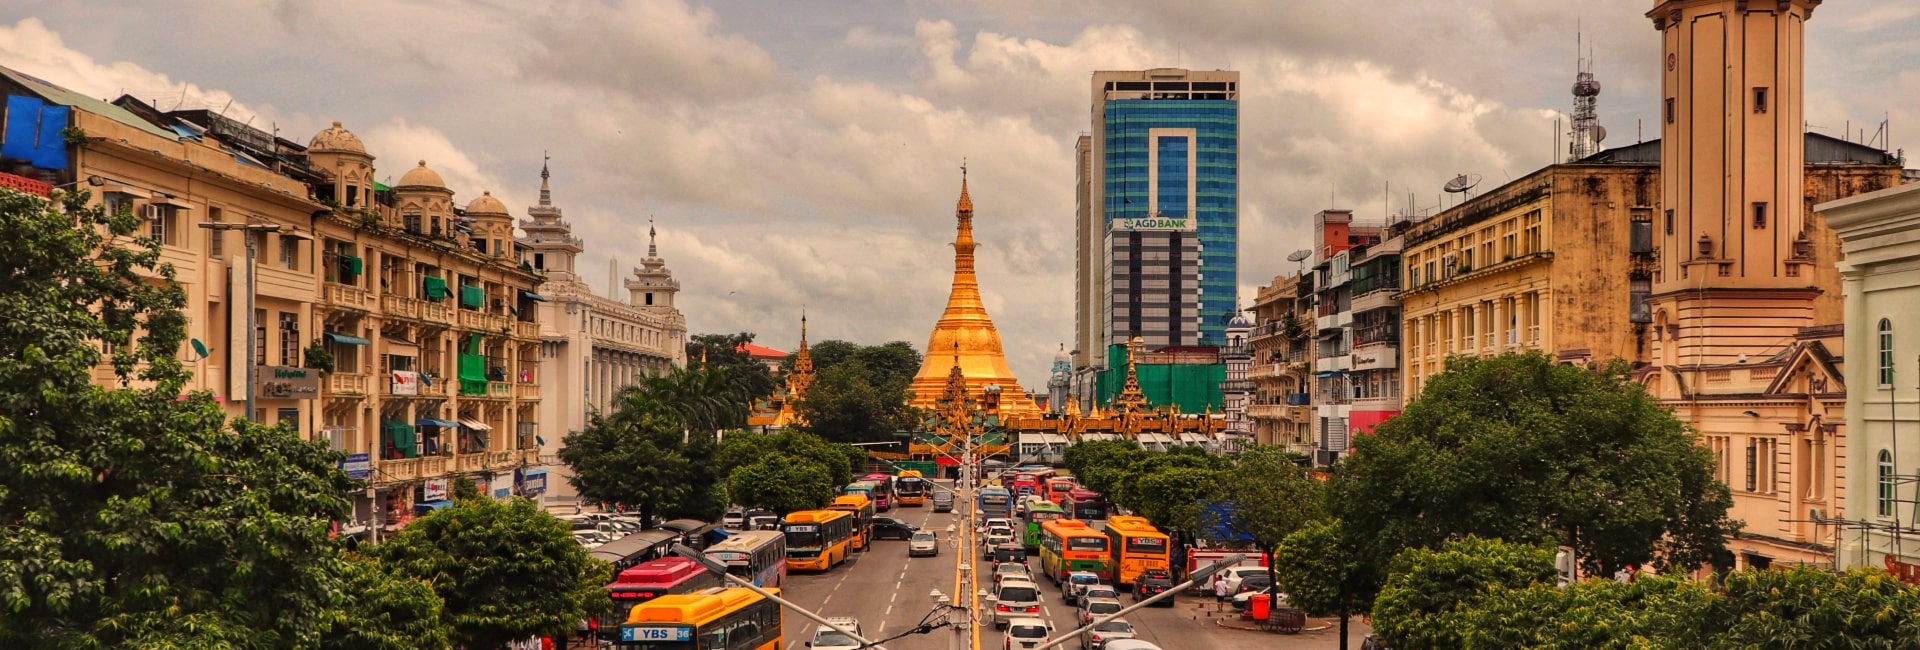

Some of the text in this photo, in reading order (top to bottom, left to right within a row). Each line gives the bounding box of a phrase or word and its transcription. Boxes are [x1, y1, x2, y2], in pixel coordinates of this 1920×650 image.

[1135, 219, 1186, 228] AGD BANK
[643, 629, 689, 639] YBS 36
